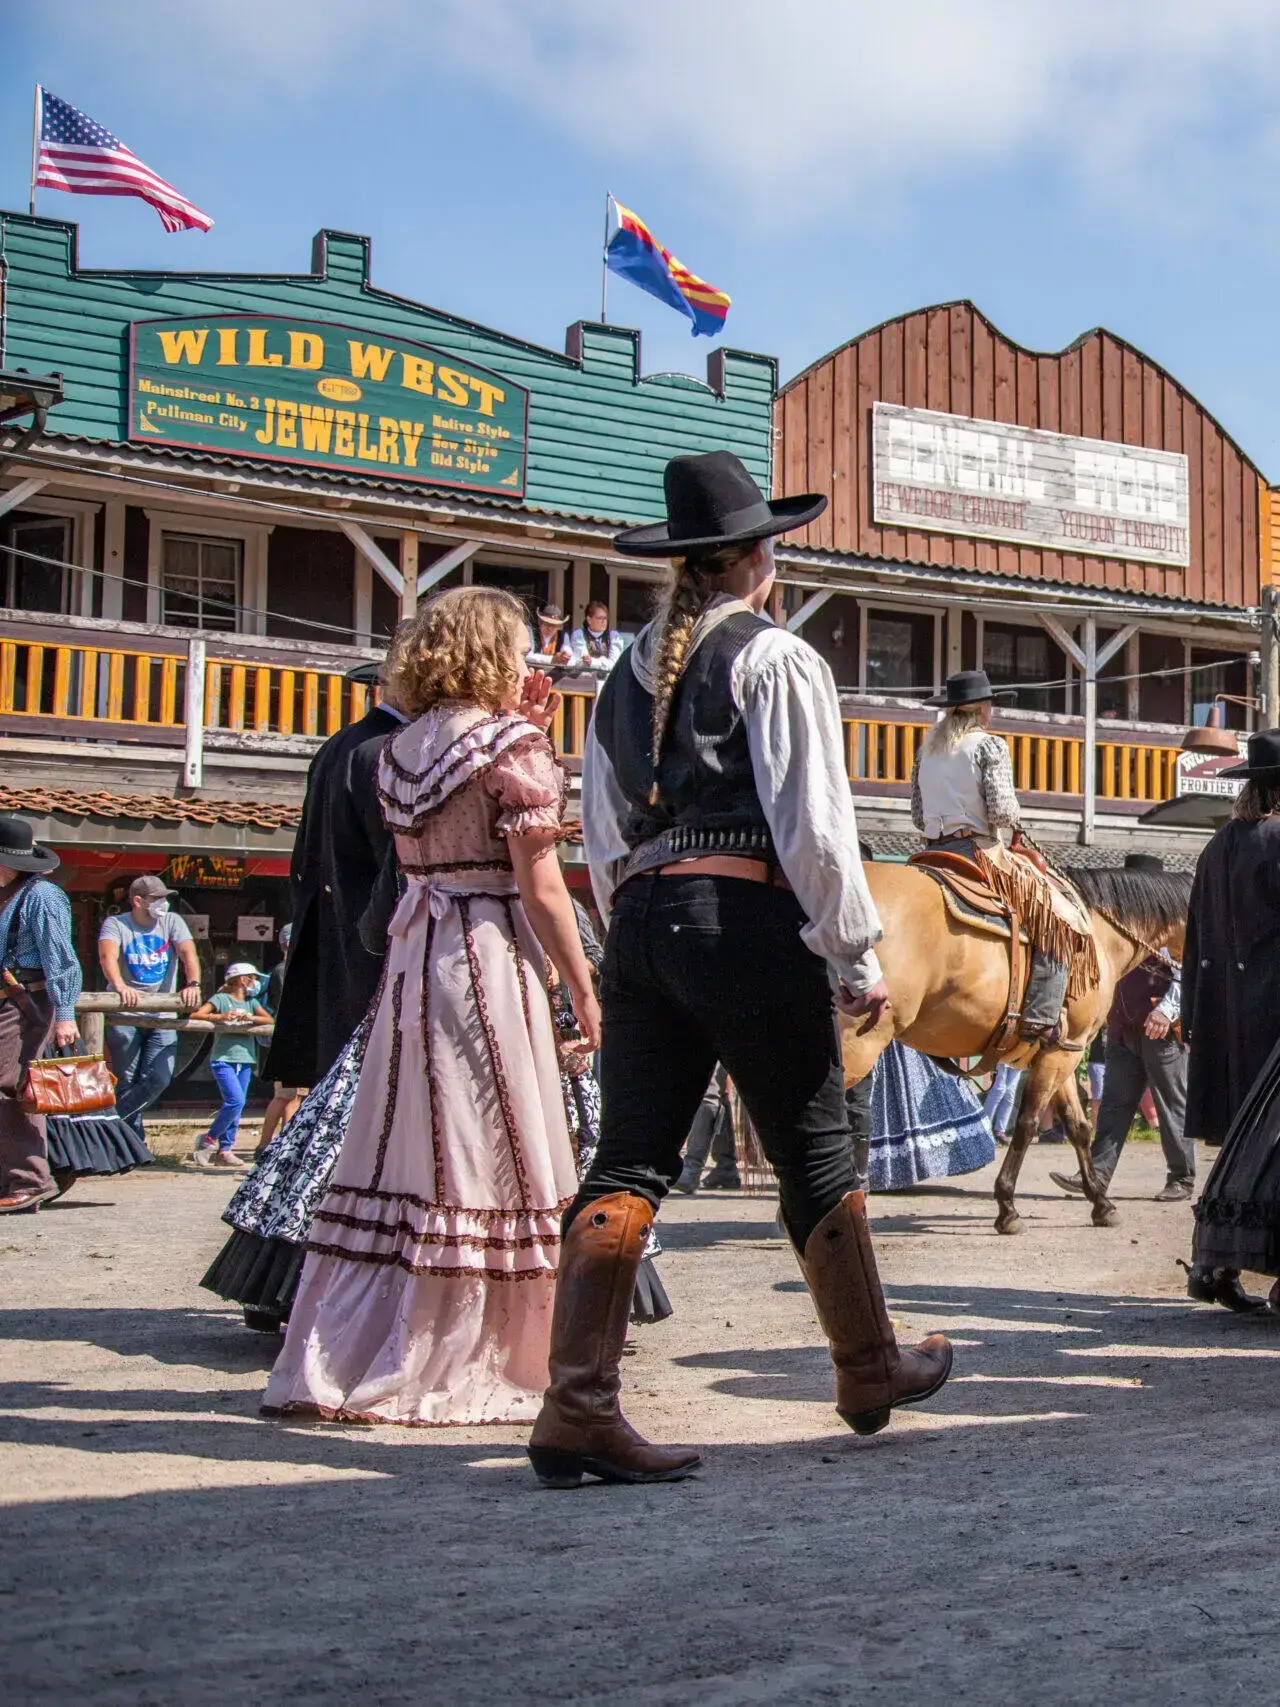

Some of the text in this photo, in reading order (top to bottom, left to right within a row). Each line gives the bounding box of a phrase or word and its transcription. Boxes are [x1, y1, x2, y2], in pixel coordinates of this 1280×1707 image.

[156, 328, 505, 418] WILD WEST
[138, 379, 260, 410] Mainstreet No. 3
[147, 401, 248, 432] Pullman City
[432, 414, 511, 440] Native Style
[255, 397, 424, 467] JEWELRY
[432, 433, 498, 458] New Style
[431, 452, 490, 474] Old Style
[888, 418, 1178, 522] GENERAL STORE
[1181, 780, 1234, 795] FRONTIER
[127, 951, 168, 965] NASA
